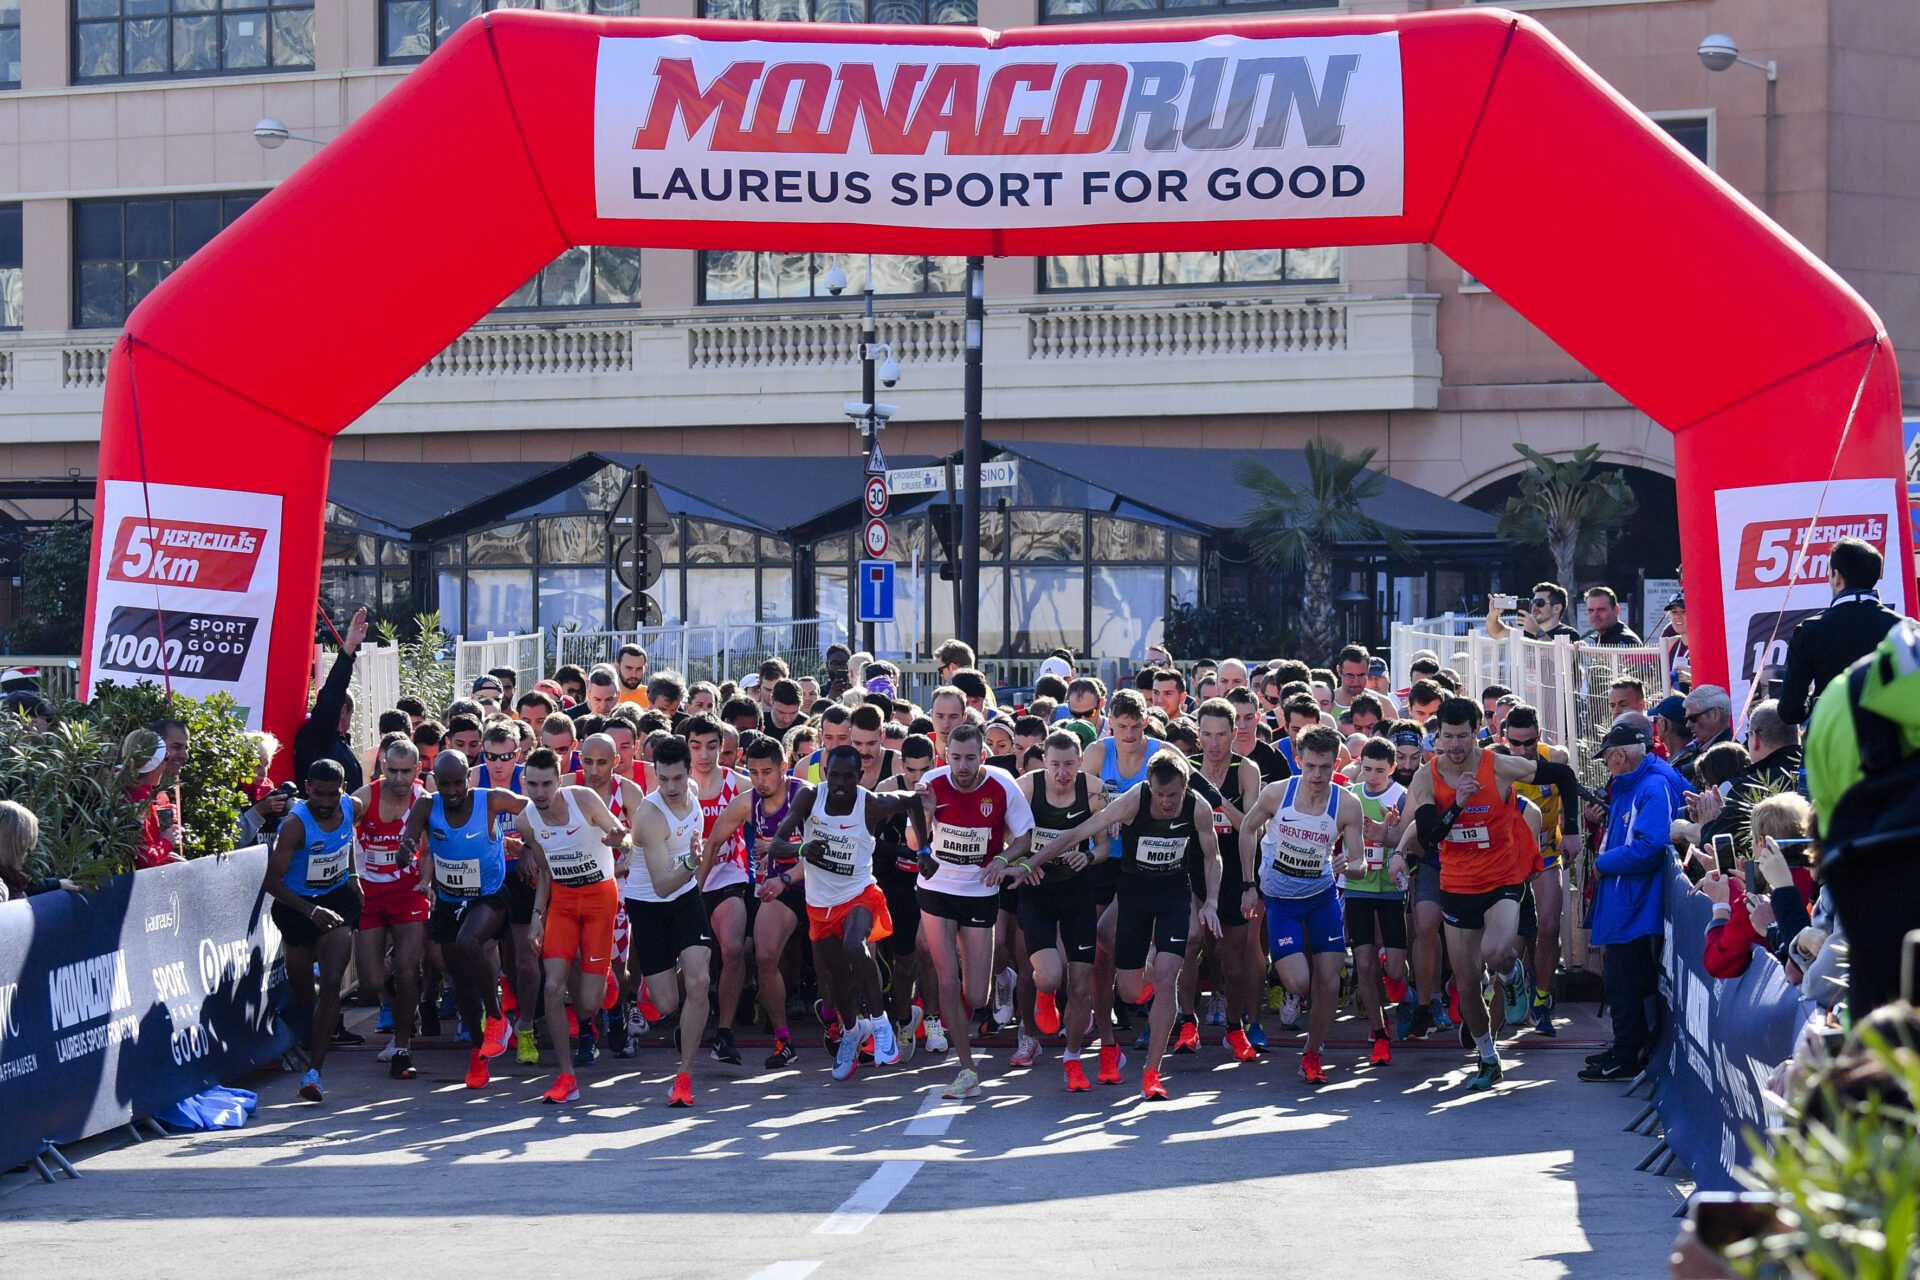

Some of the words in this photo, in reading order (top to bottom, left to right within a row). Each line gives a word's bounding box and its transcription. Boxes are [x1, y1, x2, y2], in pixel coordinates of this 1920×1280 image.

[632, 166, 872, 202] LAUREUS
[890, 171, 1062, 206] SPORT
[1082, 169, 1187, 205] FOR
[1207, 164, 1366, 201] GOOD
[980, 468, 1006, 482] SINO
[870, 488, 884, 505] 30
[190, 618, 247, 635] SPORT
[188, 639, 244, 655] GOOD
[1279, 823, 1302, 838] GREAT
[1301, 830, 1330, 843] BRITAIN
[1461, 829, 1478, 839] 113
[943, 839, 980, 853] BARRER
[826, 849, 853, 861] ANGAT
[1147, 850, 1177, 862] MOEN
[1279, 850, 1321, 868] TRAYNOR
[552, 859, 598, 876] WANDERS
[447, 874, 463, 886] ALI
[152, 960, 191, 1002] SPORT
[56, 1032, 89, 1064] LAUREUS
[86, 1025, 108, 1053] SPORT
[171, 1023, 209, 1066] GOOD
[0, 1053, 38, 1083] AFFHAUSEN
